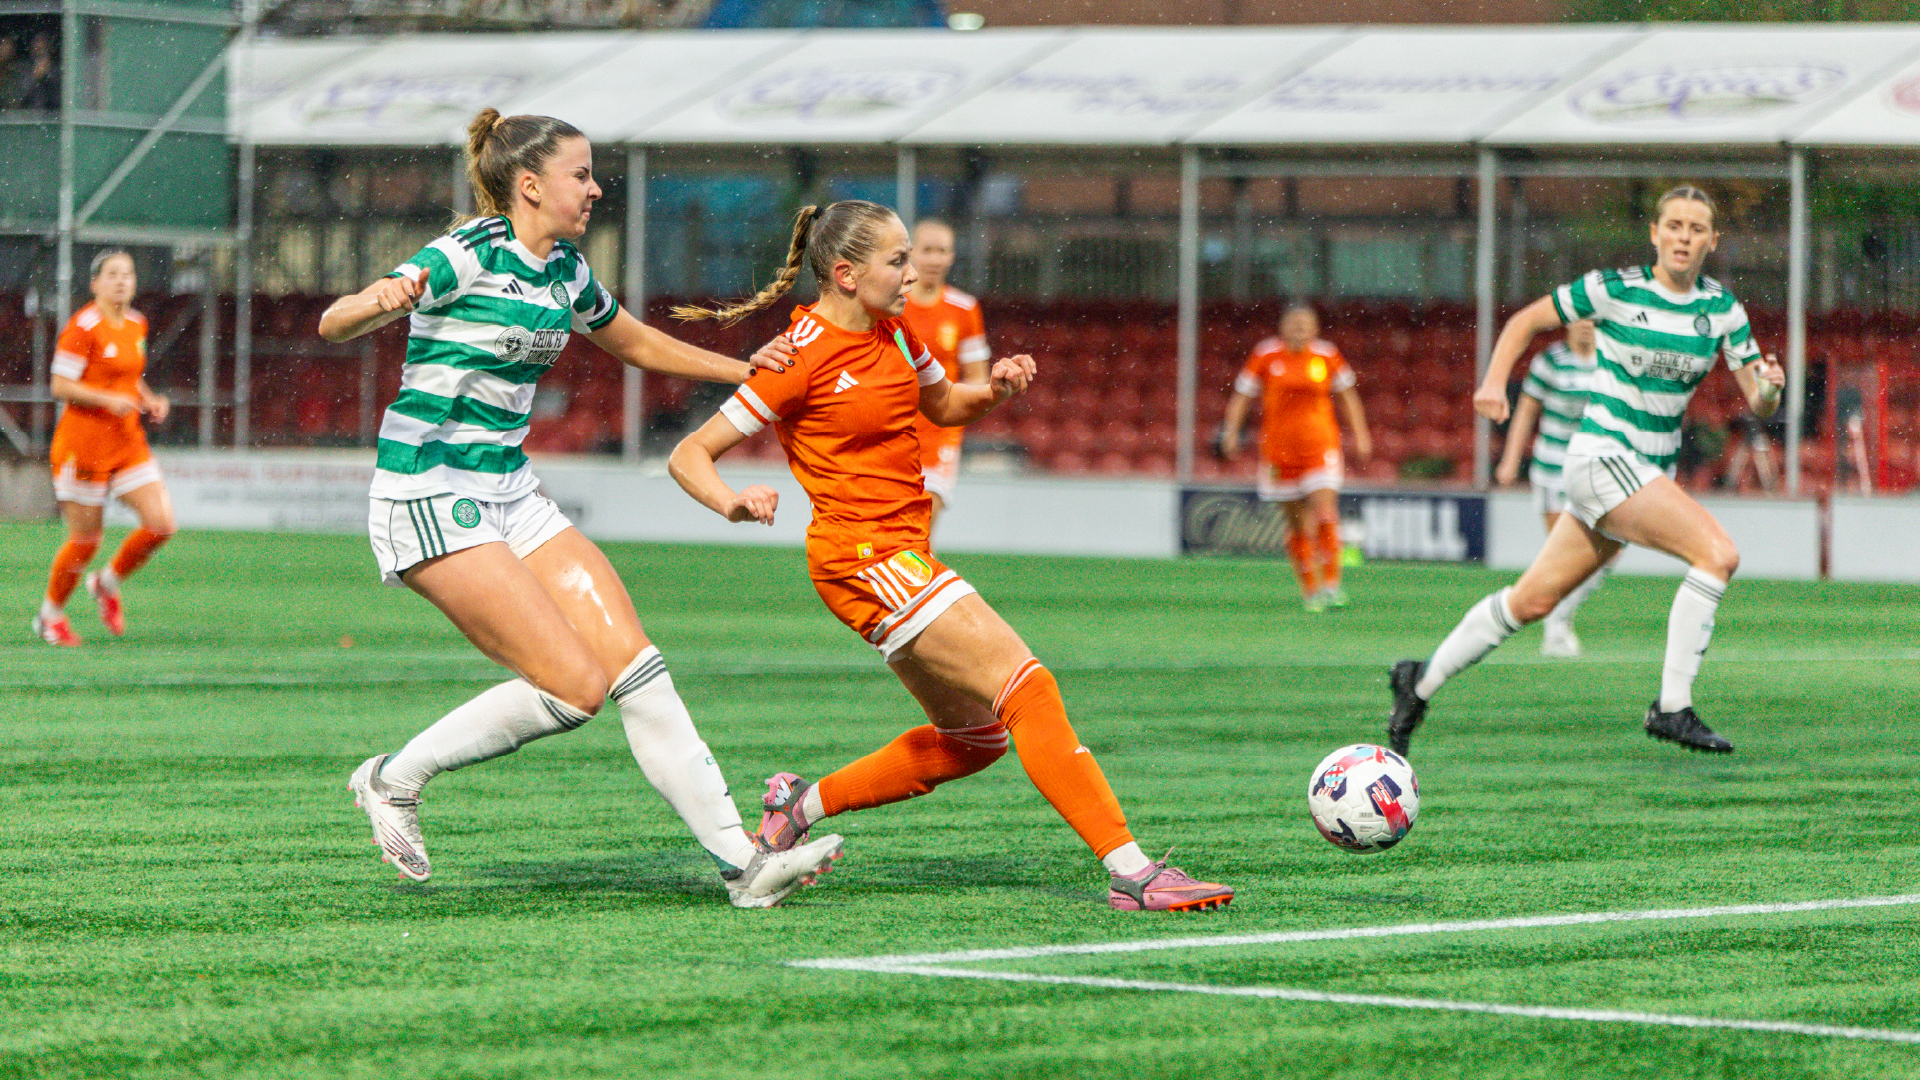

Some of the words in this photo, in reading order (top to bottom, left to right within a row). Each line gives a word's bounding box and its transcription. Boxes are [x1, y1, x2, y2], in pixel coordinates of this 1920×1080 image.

[532, 330, 555, 348] CELTIC
[554, 330, 565, 348] FC
[1653, 351, 1681, 367] CELTIC
[1360, 499, 1467, 560] HILL
